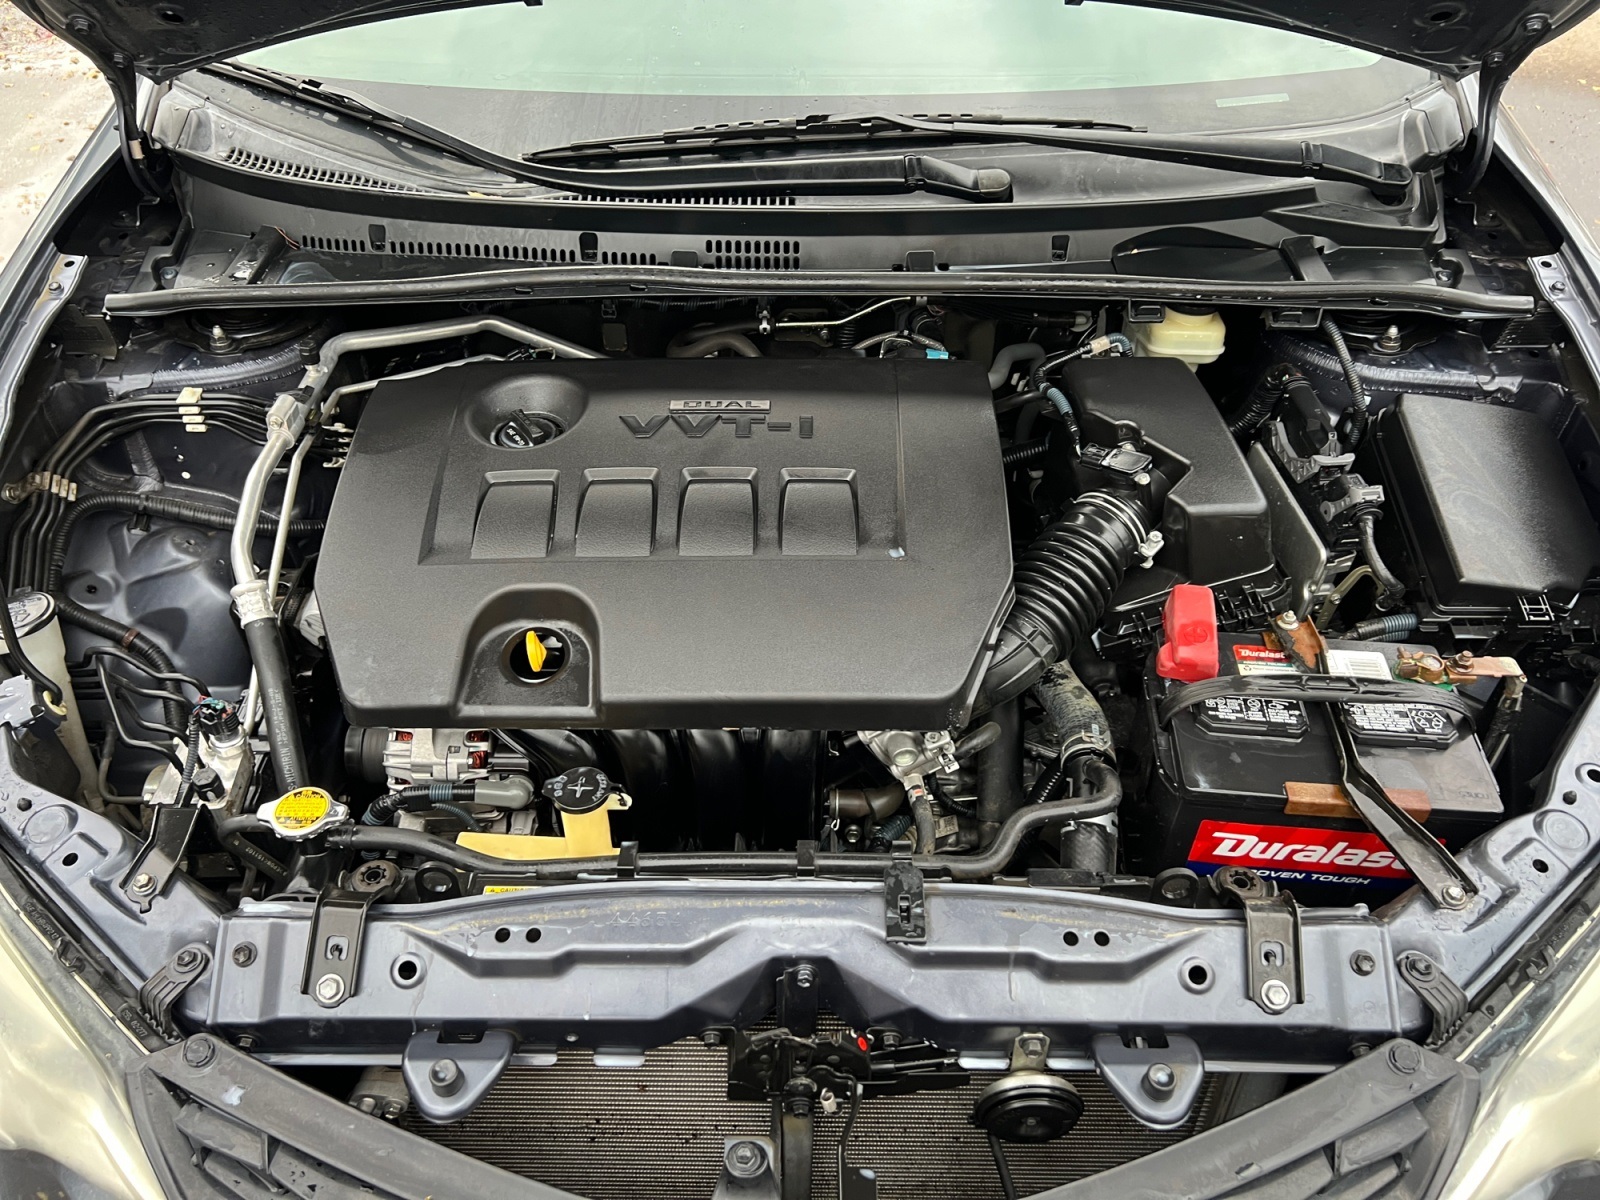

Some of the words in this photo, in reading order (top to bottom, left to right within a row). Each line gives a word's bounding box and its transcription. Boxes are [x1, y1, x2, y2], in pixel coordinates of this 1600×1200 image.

[683, 400, 762, 408] DUAL
[1238, 648, 1286, 659] Duralast
[1250, 869, 1307, 880] OVEN
[1311, 873, 1371, 885] TOUGH
